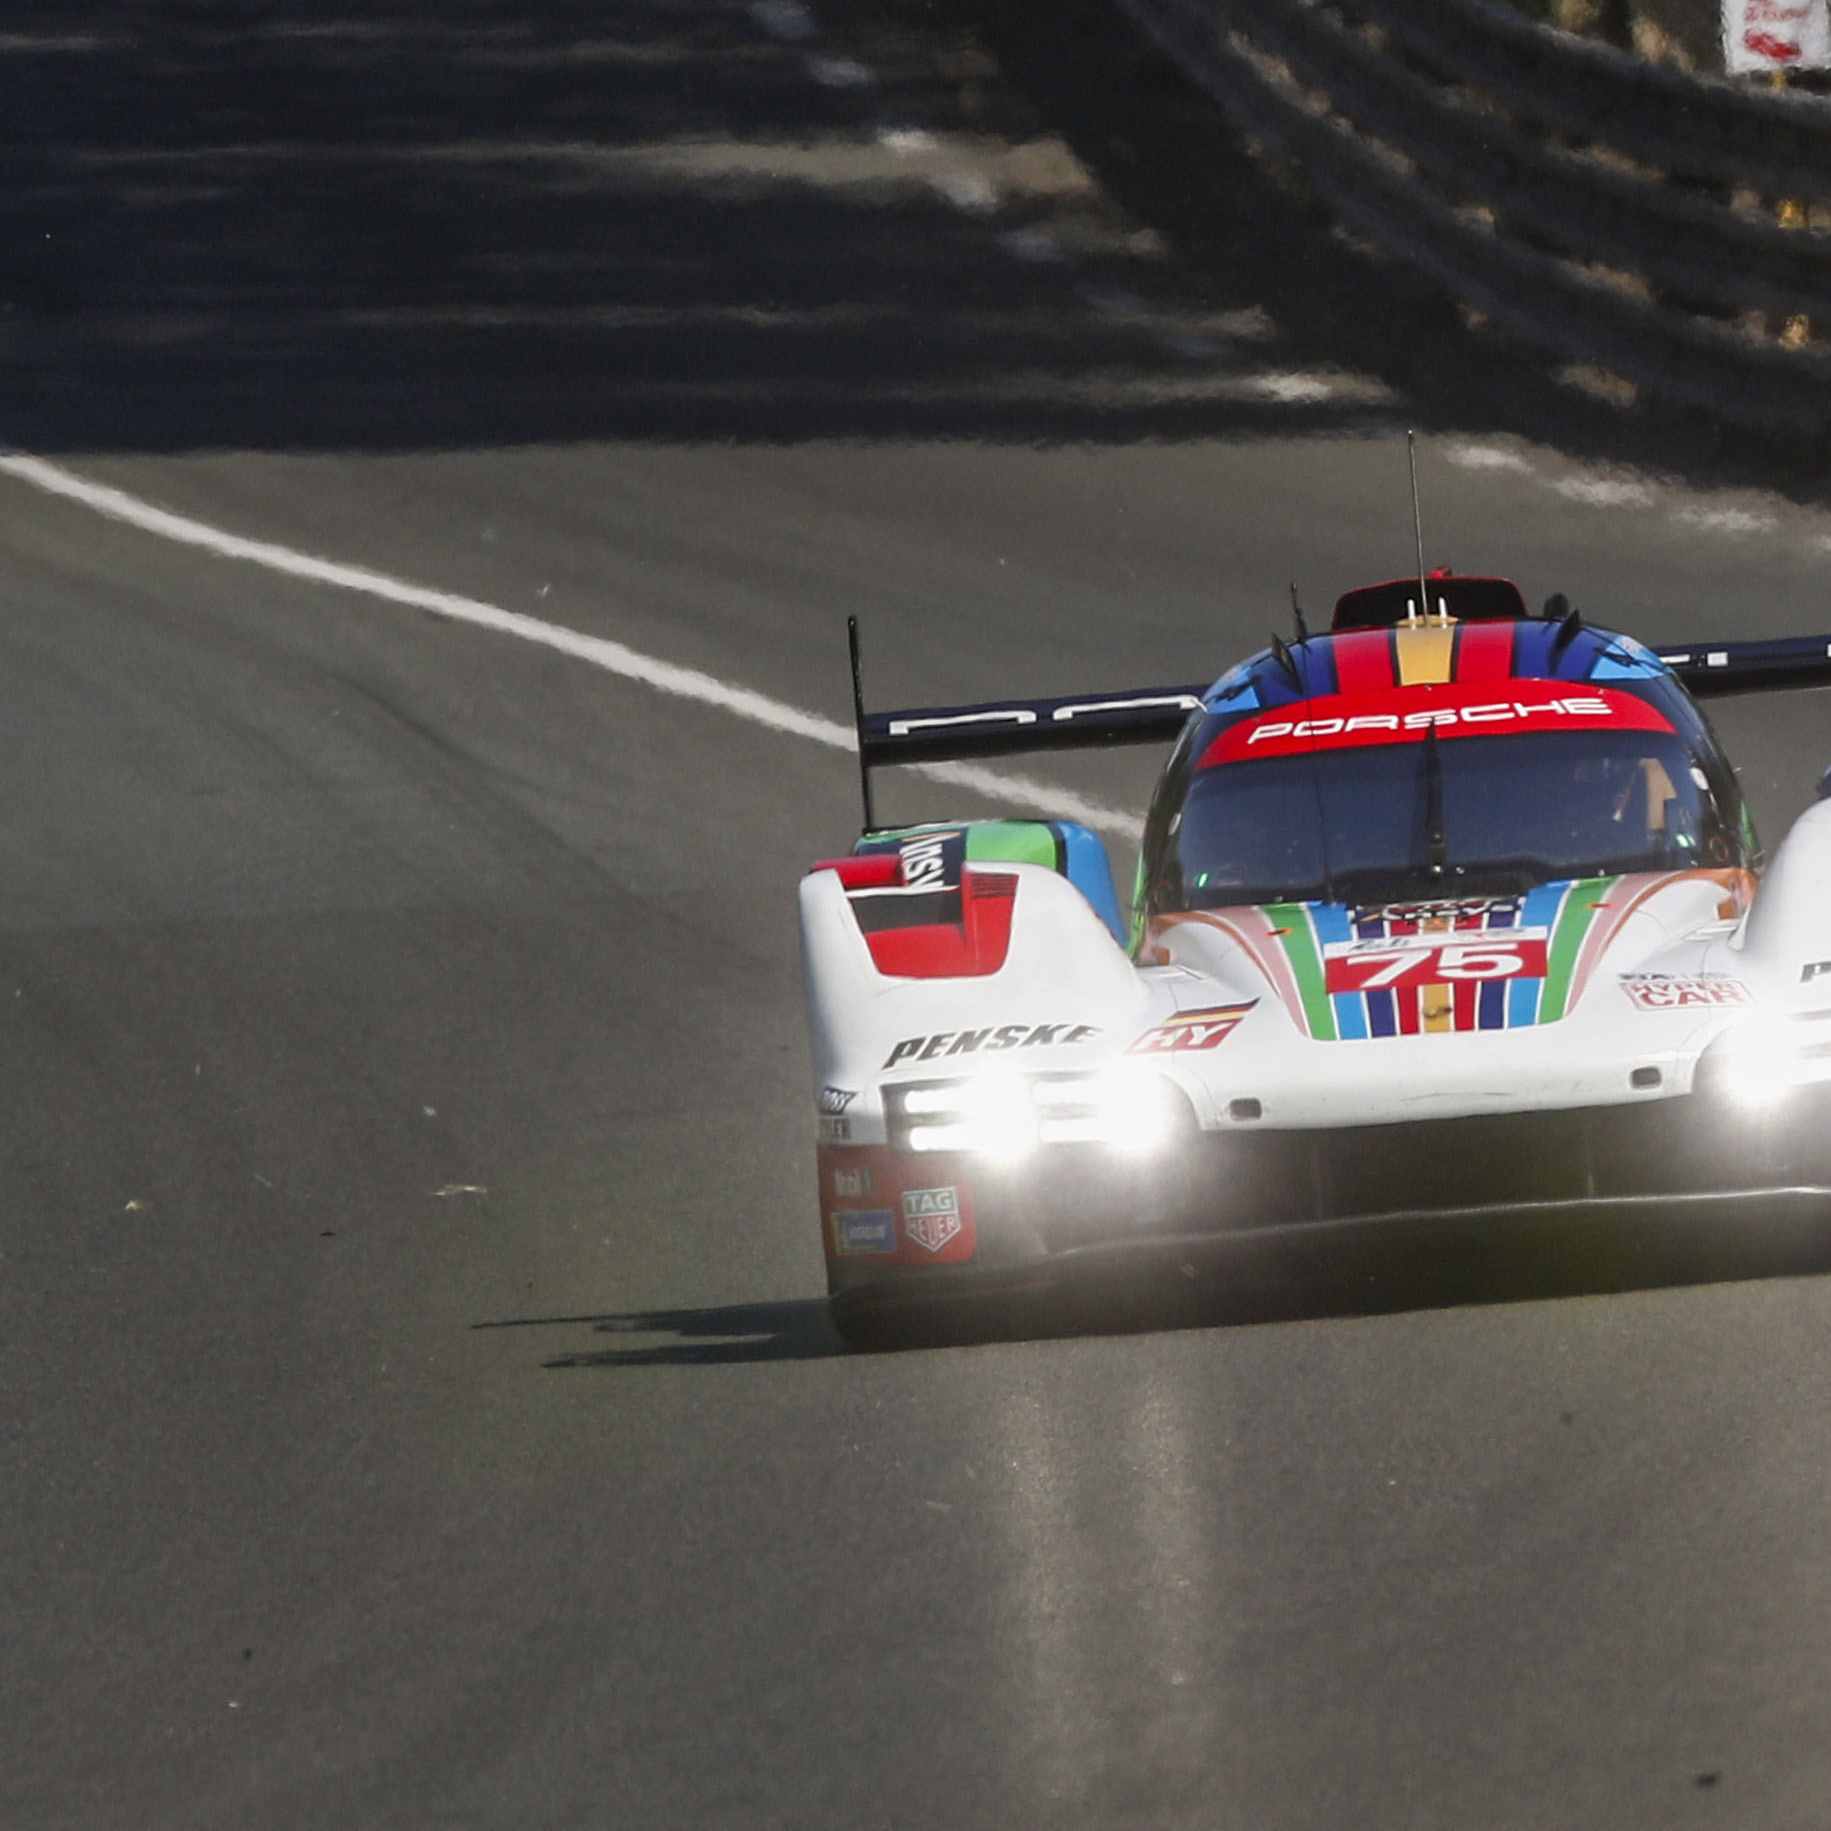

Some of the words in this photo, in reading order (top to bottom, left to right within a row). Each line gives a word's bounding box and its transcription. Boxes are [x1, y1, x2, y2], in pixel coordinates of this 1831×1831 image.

[1246, 697, 1613, 746] PORSCHE
[1346, 942, 1524, 988] 75
[882, 1023, 1104, 1070] PENSKE
[905, 1192, 952, 1214] TAG
